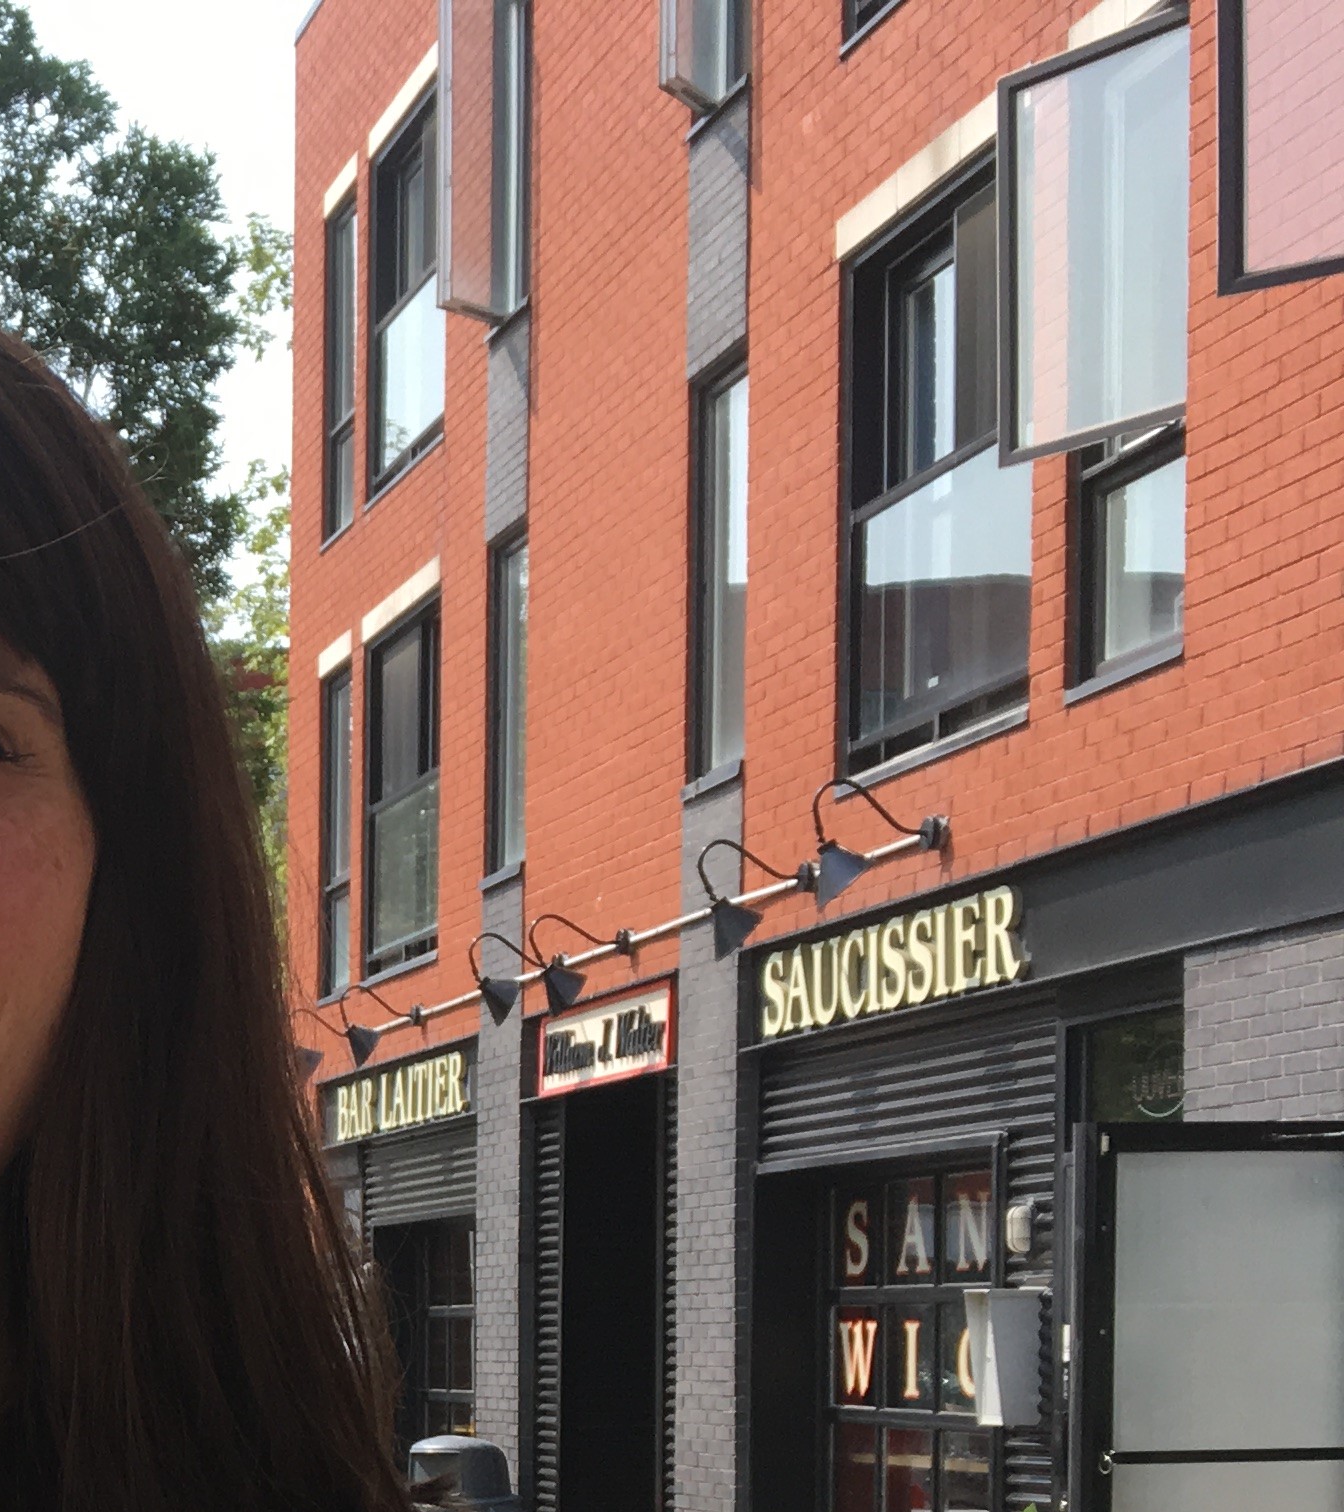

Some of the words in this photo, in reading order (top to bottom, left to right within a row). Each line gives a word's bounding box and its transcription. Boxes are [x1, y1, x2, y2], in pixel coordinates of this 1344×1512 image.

[763, 885, 1021, 1037] SAUCISSIER
[337, 1078, 374, 1141] BAR
[379, 1051, 467, 1131] LAITIER
[846, 1191, 990, 1276] SAN
